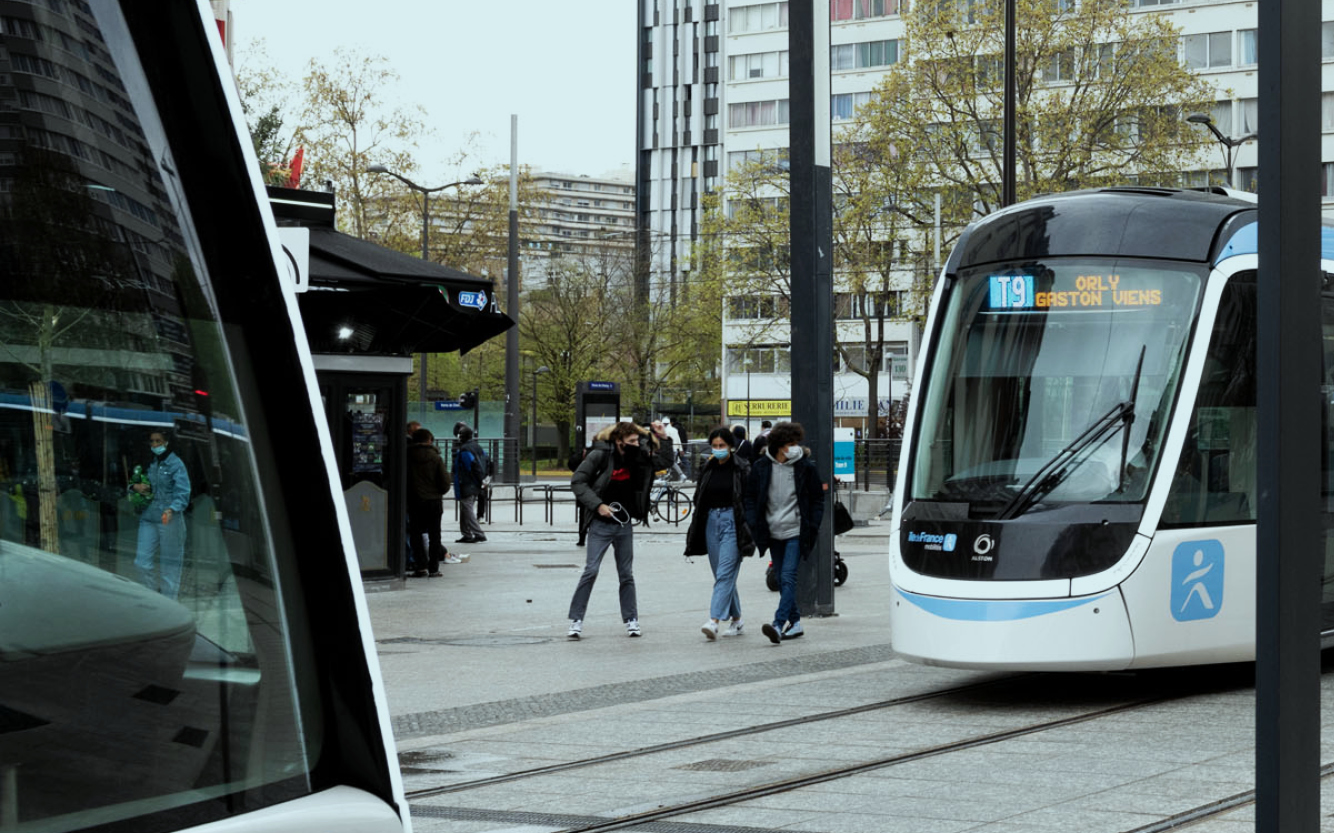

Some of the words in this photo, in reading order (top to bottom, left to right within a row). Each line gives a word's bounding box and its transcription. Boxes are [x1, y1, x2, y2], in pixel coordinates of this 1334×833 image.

[998, 276, 1026, 307] T9
[1075, 275, 1120, 291] ORLY
[461, 294, 475, 304] FDJ
[1035, 291, 1102, 307] GASTON
[1112, 289, 1162, 306] VIENS
